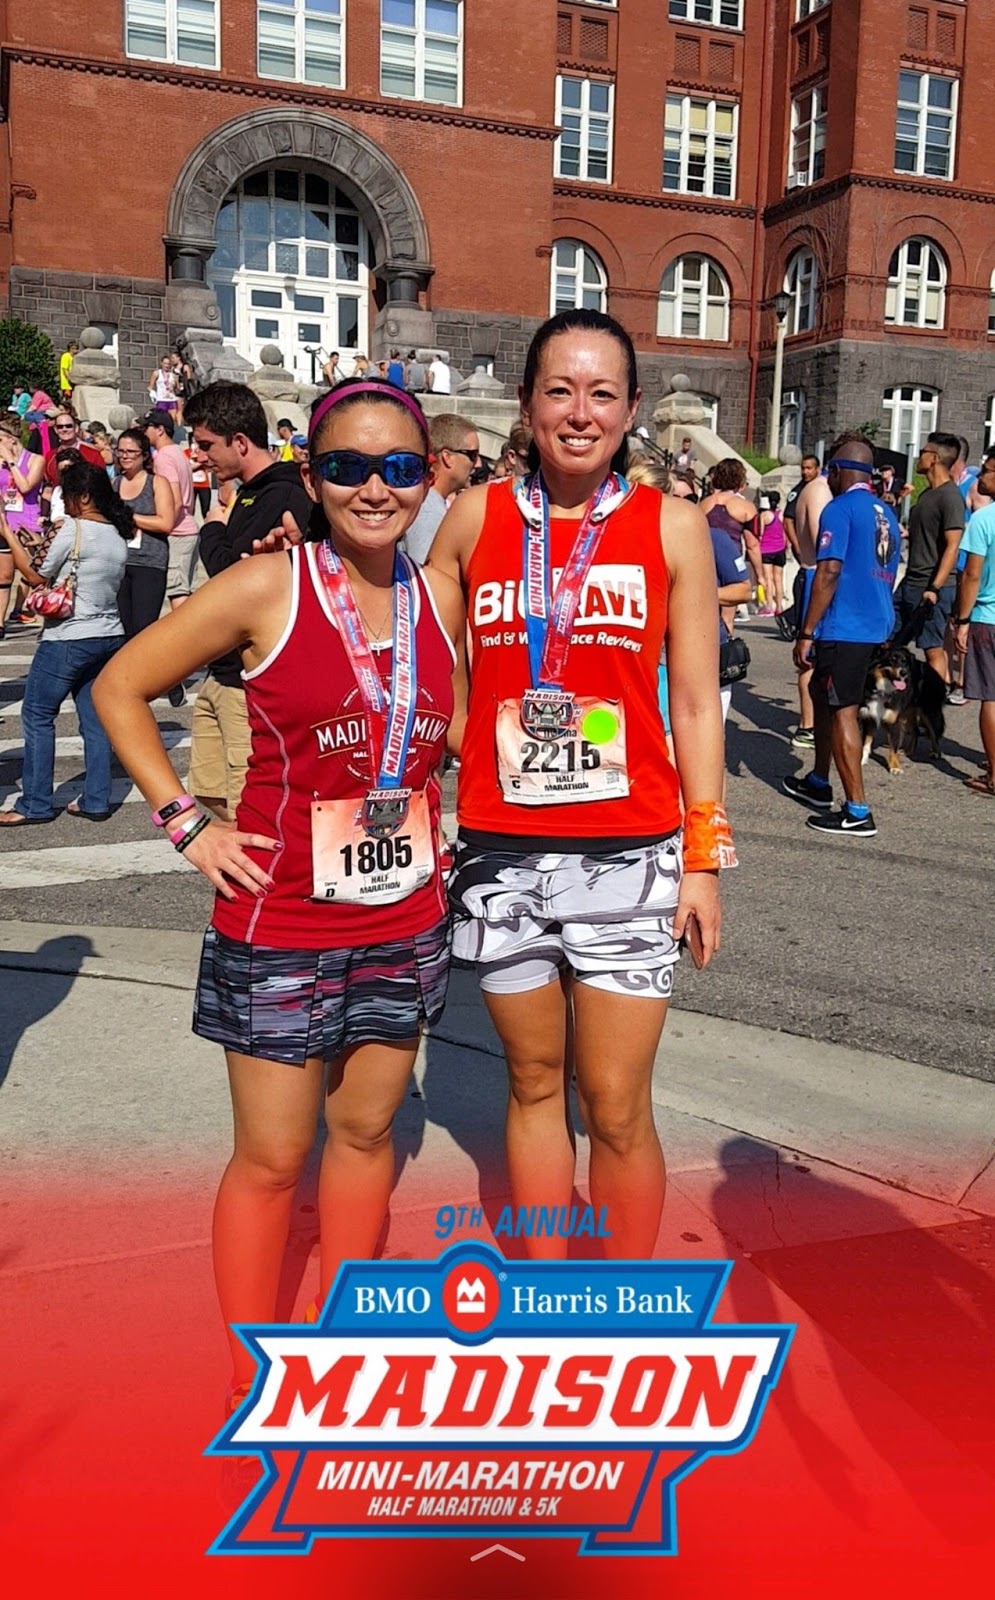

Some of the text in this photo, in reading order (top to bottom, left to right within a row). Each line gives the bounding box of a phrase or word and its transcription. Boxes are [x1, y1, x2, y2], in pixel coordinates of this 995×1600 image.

[577, 580, 643, 620] AVE
[504, 632, 516, 646] &
[570, 634, 594, 645] ace
[386, 586, 410, 774] MADISON MINI-MARATHON
[526, 692, 573, 701] MADISON
[316, 718, 367, 752] MADI
[520, 740, 601, 773] 2215
[511, 779, 521, 789] C
[556, 774, 575, 783] HALF
[544, 782, 589, 791] MARATHON
[369, 789, 410, 799] MADISON
[340, 835, 412, 877] 1805
[371, 874, 389, 884] HALF
[325, 888, 336, 898] D
[359, 881, 401, 894] MARATHON
